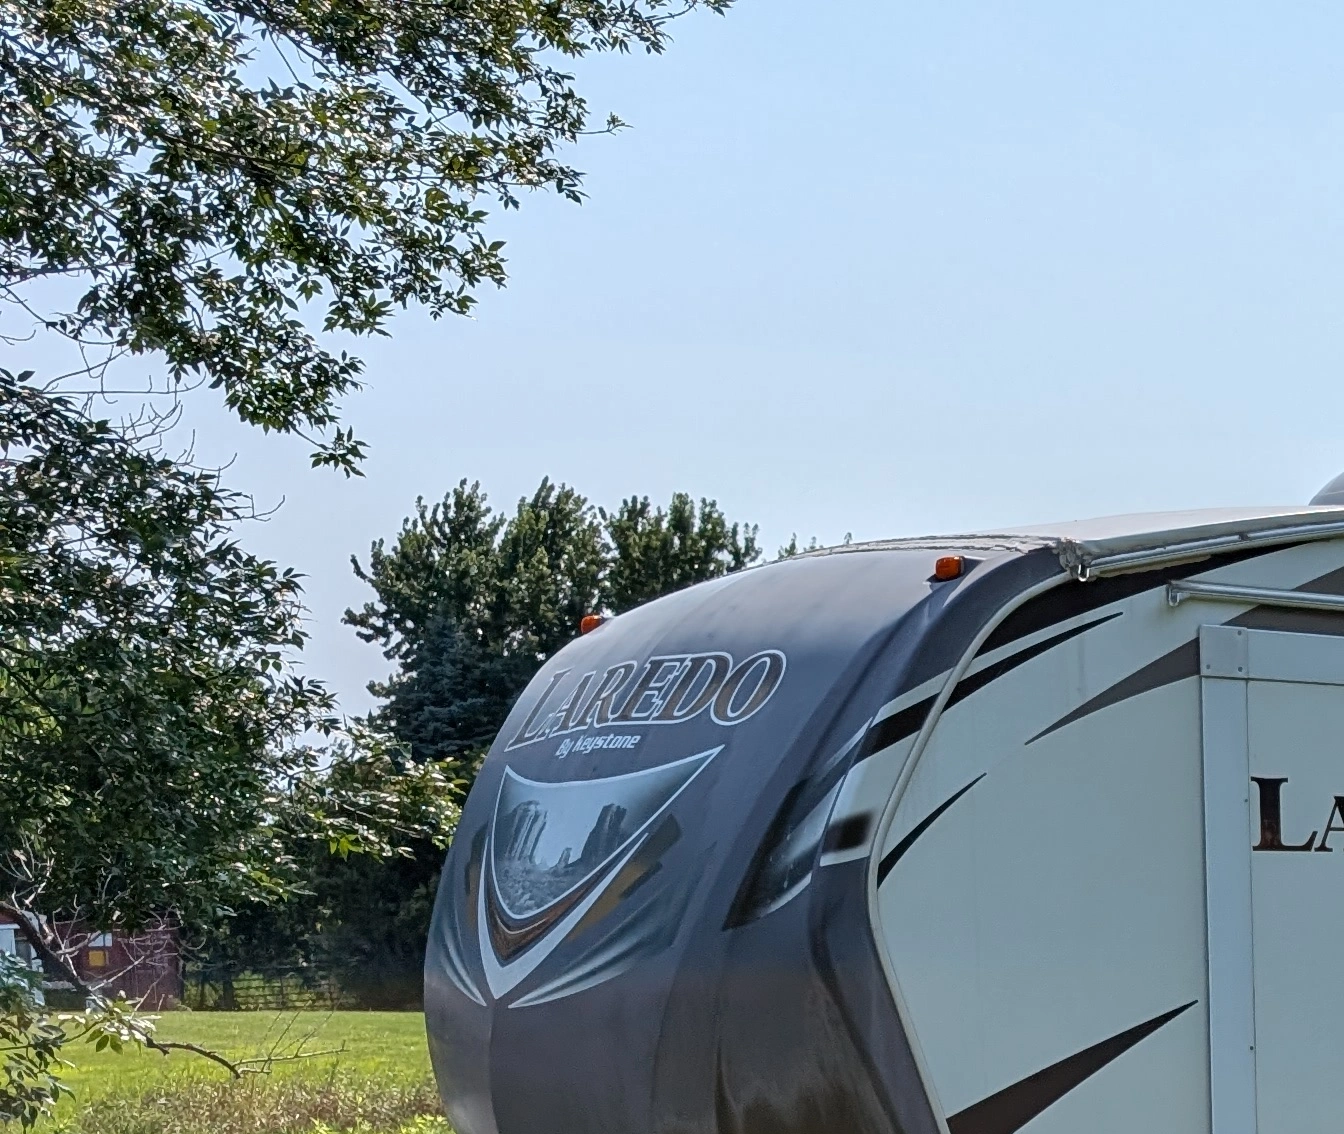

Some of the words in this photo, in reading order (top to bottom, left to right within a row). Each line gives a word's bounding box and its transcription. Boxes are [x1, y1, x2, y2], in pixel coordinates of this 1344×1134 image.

[505, 649, 787, 752] LAREDO
[555, 738, 575, 759] By
[572, 733, 642, 754] Keystone
